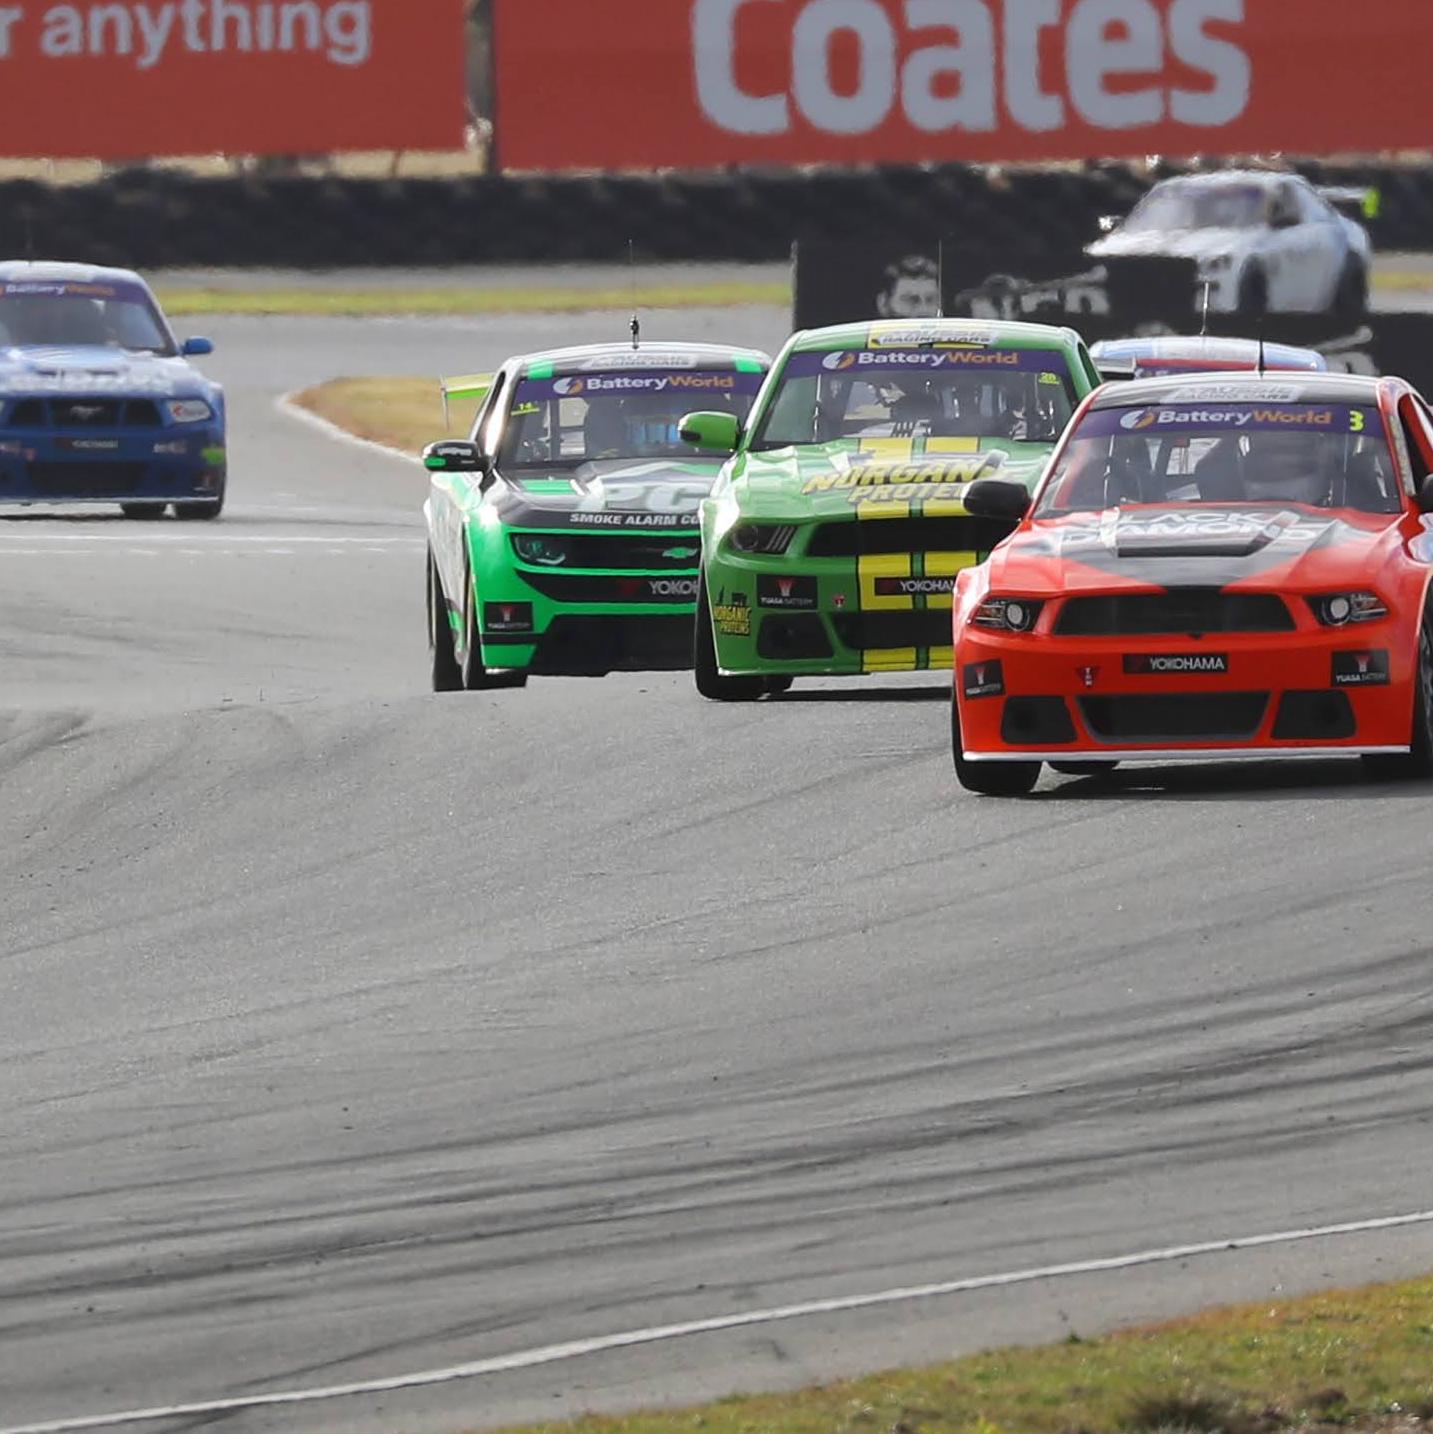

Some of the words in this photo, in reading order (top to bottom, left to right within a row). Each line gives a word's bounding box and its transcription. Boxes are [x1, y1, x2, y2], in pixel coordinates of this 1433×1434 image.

[858, 351, 1019, 367] BatteryWorld
[586, 374, 735, 391] BatteryWorld
[1157, 410, 1333, 426] BatteryWorld
[1349, 410, 1364, 432] 3
[569, 513, 623, 525] SMOKE
[624, 515, 678, 526] ALARM
[1149, 657, 1226, 670] YOKOHAMA
